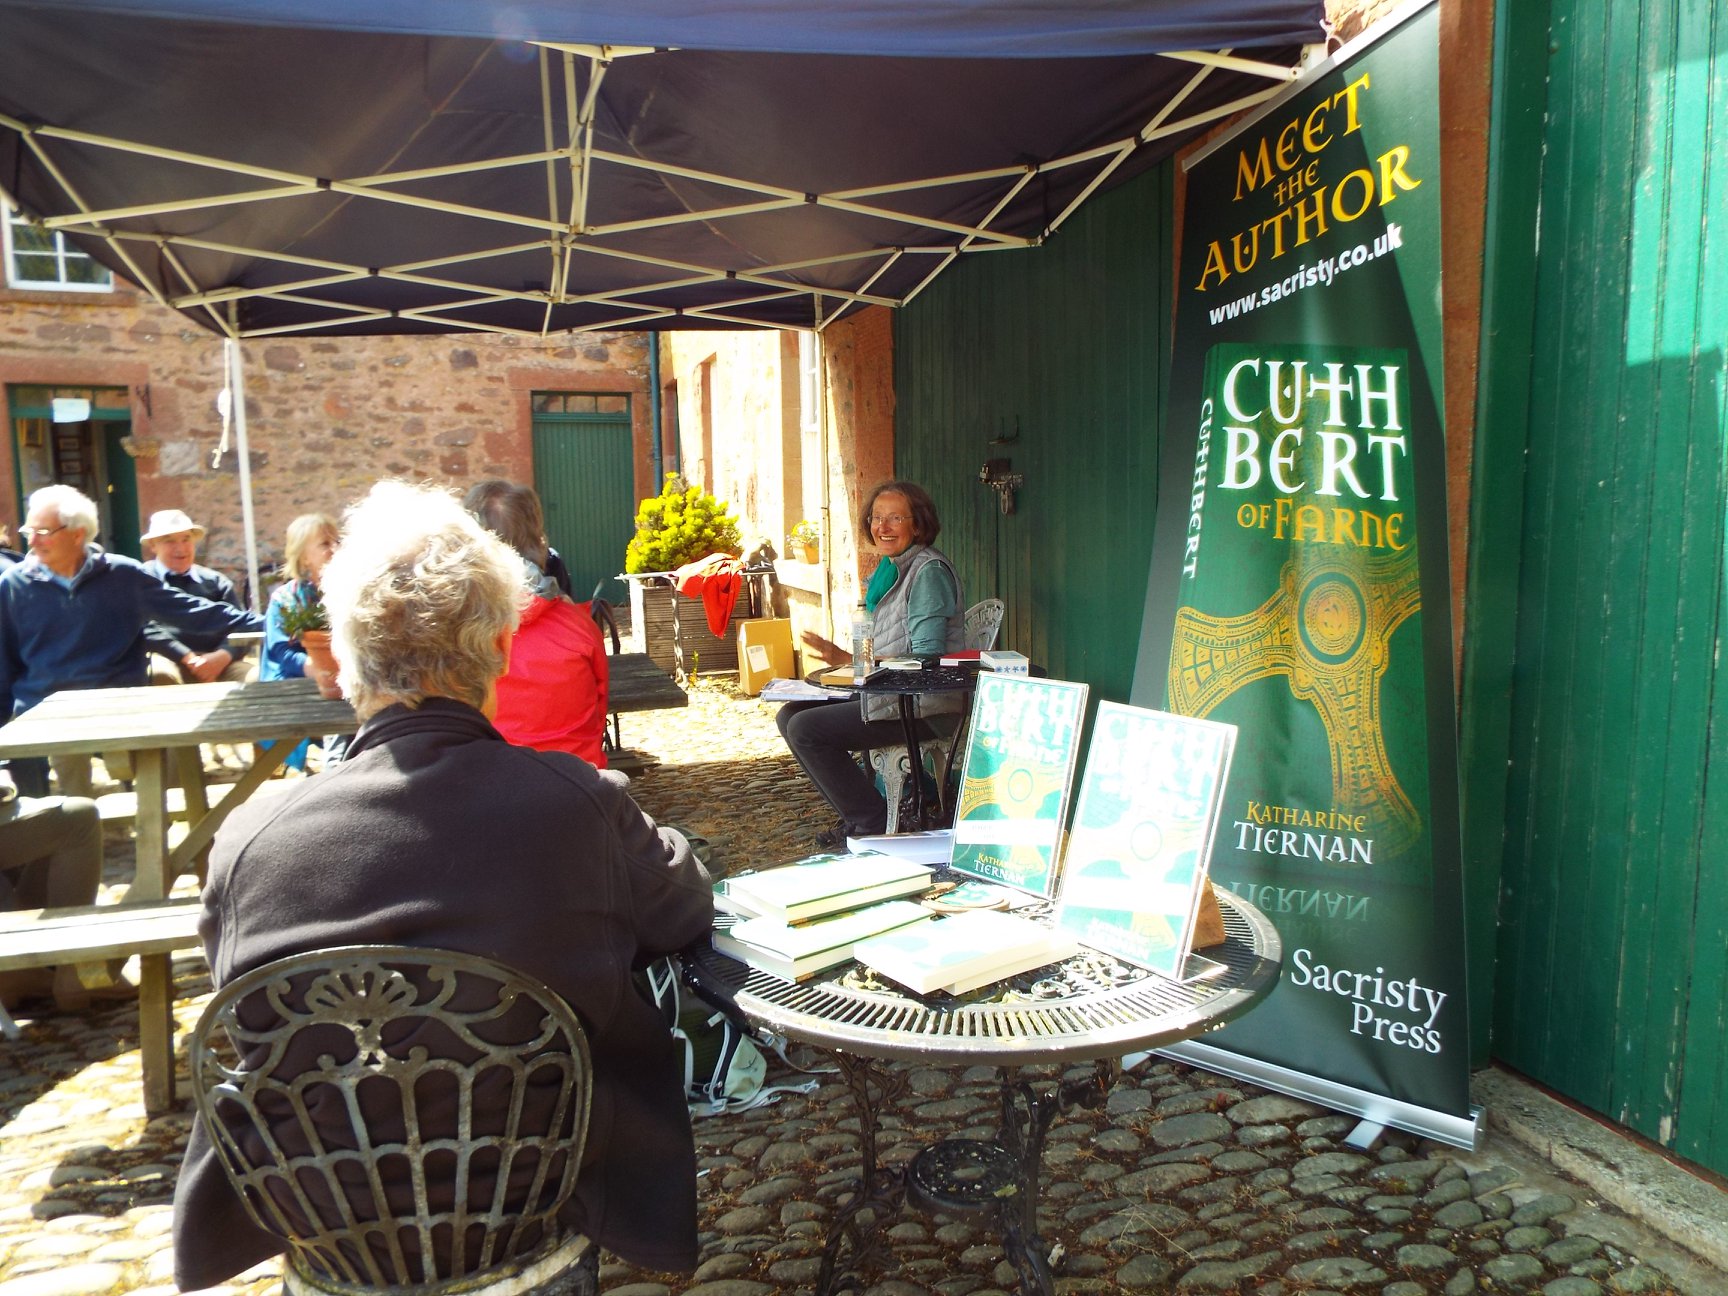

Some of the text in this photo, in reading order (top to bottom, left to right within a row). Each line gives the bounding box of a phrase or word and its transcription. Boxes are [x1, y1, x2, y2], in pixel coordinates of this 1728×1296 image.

[1232, 72, 1370, 202] MEET
[1195, 145, 1421, 291] AUTHOR
[1208, 222, 1403, 326] www.sacristy.co.uk
[1223, 358, 1402, 430] CUTH
[1183, 398, 1213, 579] CUTHBERT
[1217, 426, 1407, 502] BERT
[1237, 499, 1408, 551] OF FARNE
[1233, 820, 1374, 865] TIERNAN
[1246, 801, 1367, 833] KATHARINE
[1290, 948, 1448, 1029] Sacristy
[1349, 1001, 1442, 1053] Press
